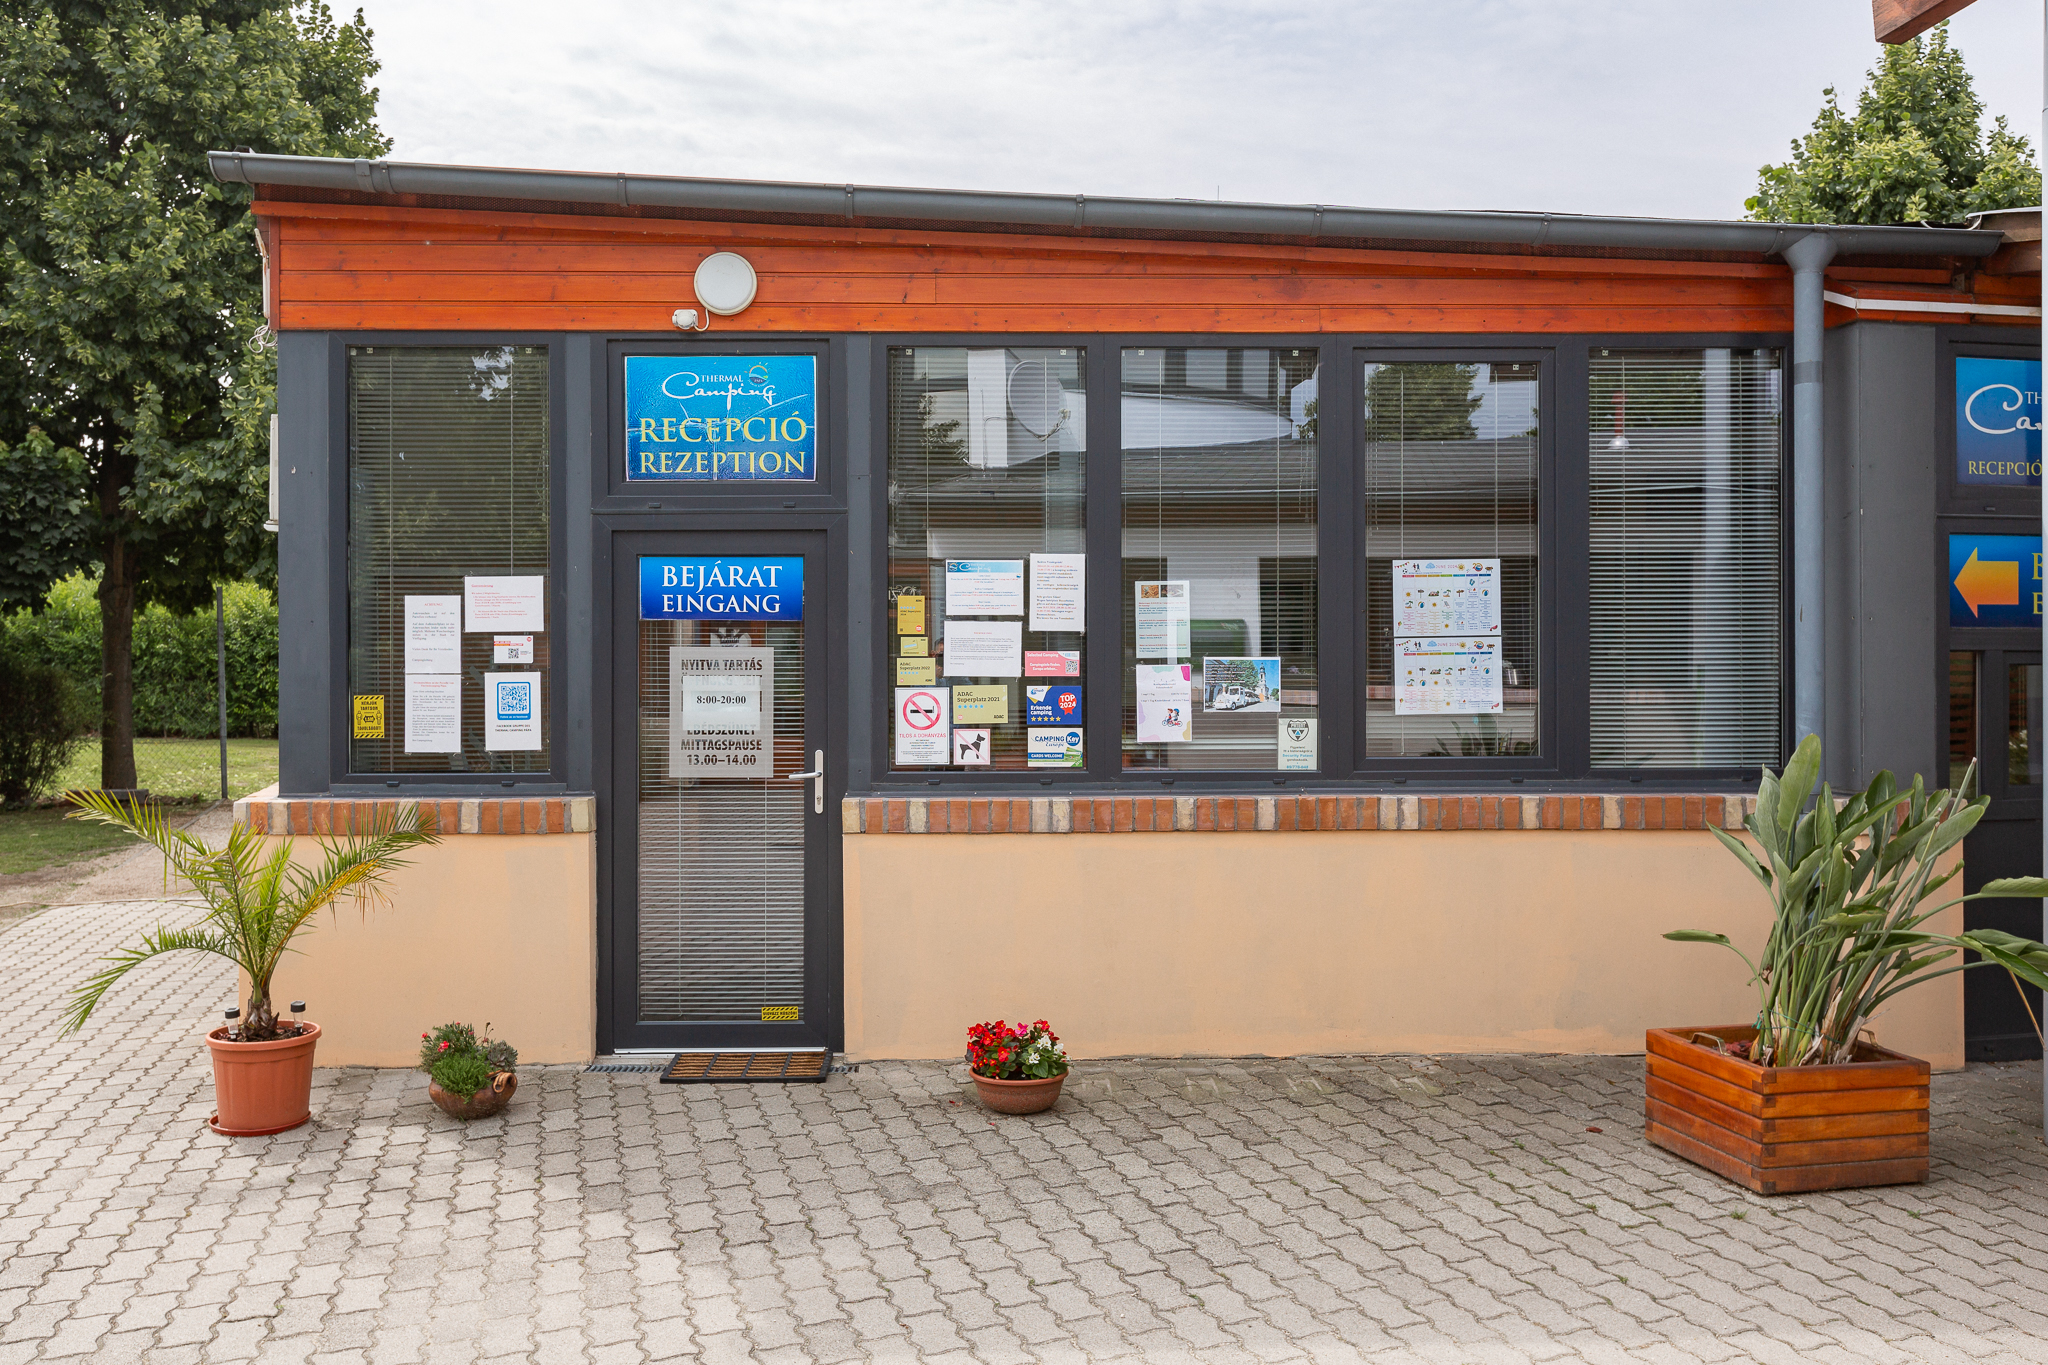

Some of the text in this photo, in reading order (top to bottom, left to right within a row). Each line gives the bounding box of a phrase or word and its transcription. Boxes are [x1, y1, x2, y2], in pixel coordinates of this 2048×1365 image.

[701, 374, 743, 383] THERMAL
[662, 372, 777, 411] Camping
[639, 411, 808, 443] RECEPCIÓ
[639, 451, 806, 474] REZEPTION
[1968, 459, 2042, 476] RECEPCIÓ
[662, 560, 783, 593] BEJÁRAT
[662, 594, 781, 613] EINGANG
[681, 656, 763, 671] NYITVA TARTÁS
[696, 695, 747, 705] 8:00-20:00
[1060, 694, 1075, 702] TOP
[680, 739, 763, 751] MITTAGSPAUSE
[1066, 735, 1080, 744] Key
[686, 754, 757, 766] 13.00–14.00
